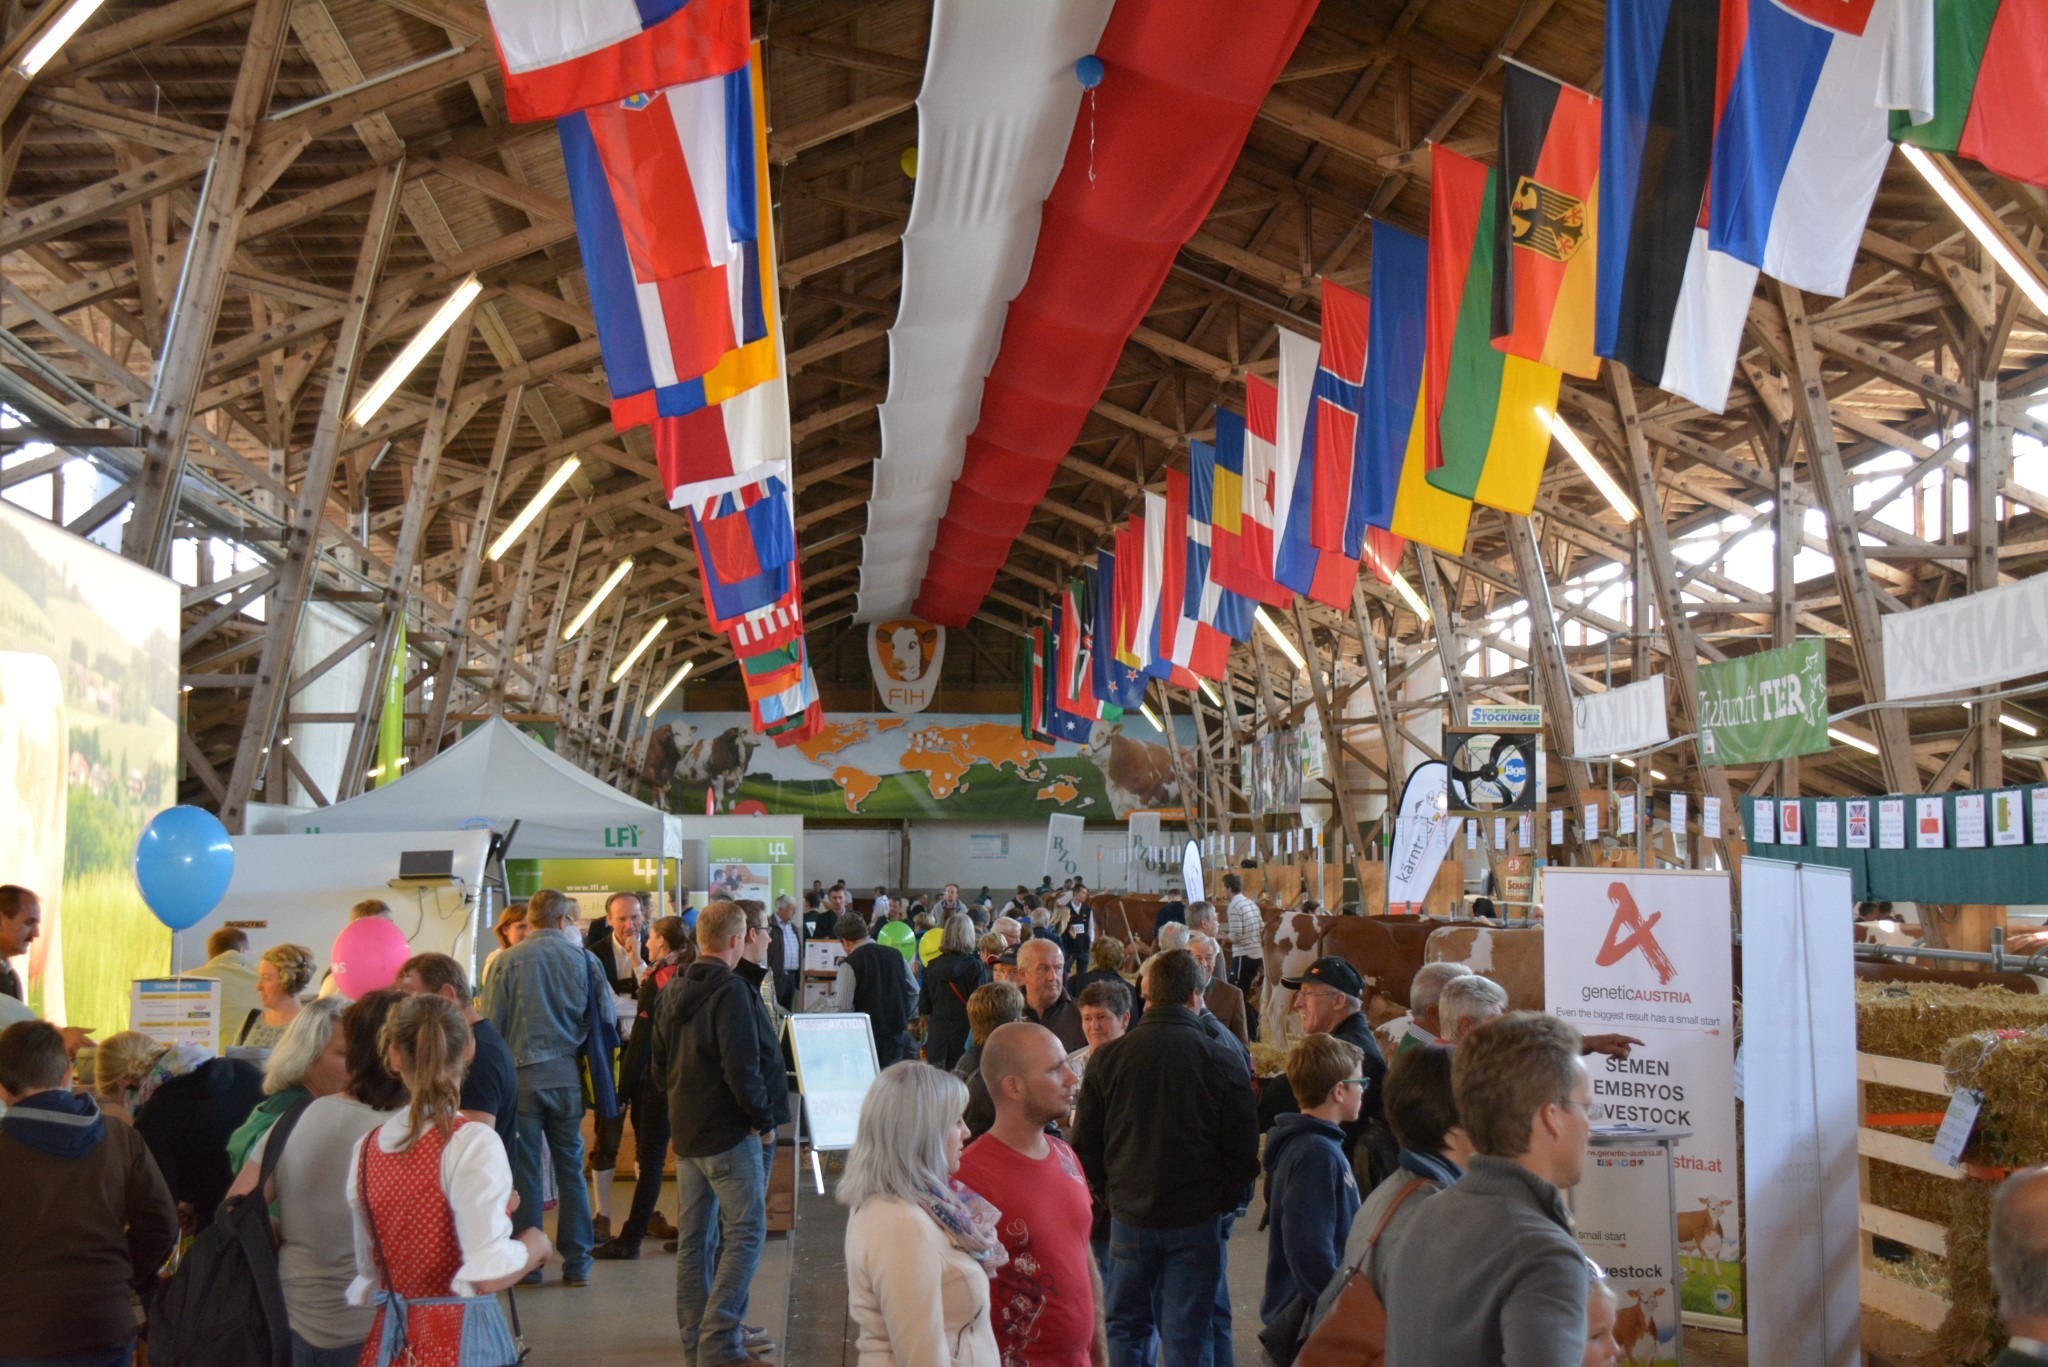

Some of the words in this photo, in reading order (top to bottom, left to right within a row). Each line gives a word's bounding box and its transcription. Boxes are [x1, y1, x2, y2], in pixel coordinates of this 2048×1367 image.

[889, 688, 924, 705] FIH
[1471, 708, 1540, 722] STOCKINGER
[1504, 765, 1526, 778] Jäge
[605, 823, 638, 847] LFI
[1053, 836, 1077, 874] RZO
[1582, 985, 1692, 1004] geneticAUSTRIA
[1556, 1006, 1577, 1017] Even
[1578, 1008, 1592, 1018] the
[1593, 1009, 1624, 1021] biggest
[1626, 1012, 1649, 1021] result
[1651, 1013, 1667, 1023] has
[1668, 1015, 1675, 1023] a
[1676, 1015, 1699, 1025] small
[1700, 1017, 1720, 1026] start
[1605, 1057, 1669, 1076] SEMEN
[1593, 1079, 1684, 1101] EMBRYOS
[1603, 1104, 1691, 1126] VESTOCK
[1587, 1149, 1663, 1157] w.genetic-austria.at
[1673, 1155, 1722, 1173] stria.at
[1578, 1230, 1602, 1240] small
[1604, 1232, 1626, 1241] start
[1604, 1264, 1663, 1278] vestock
